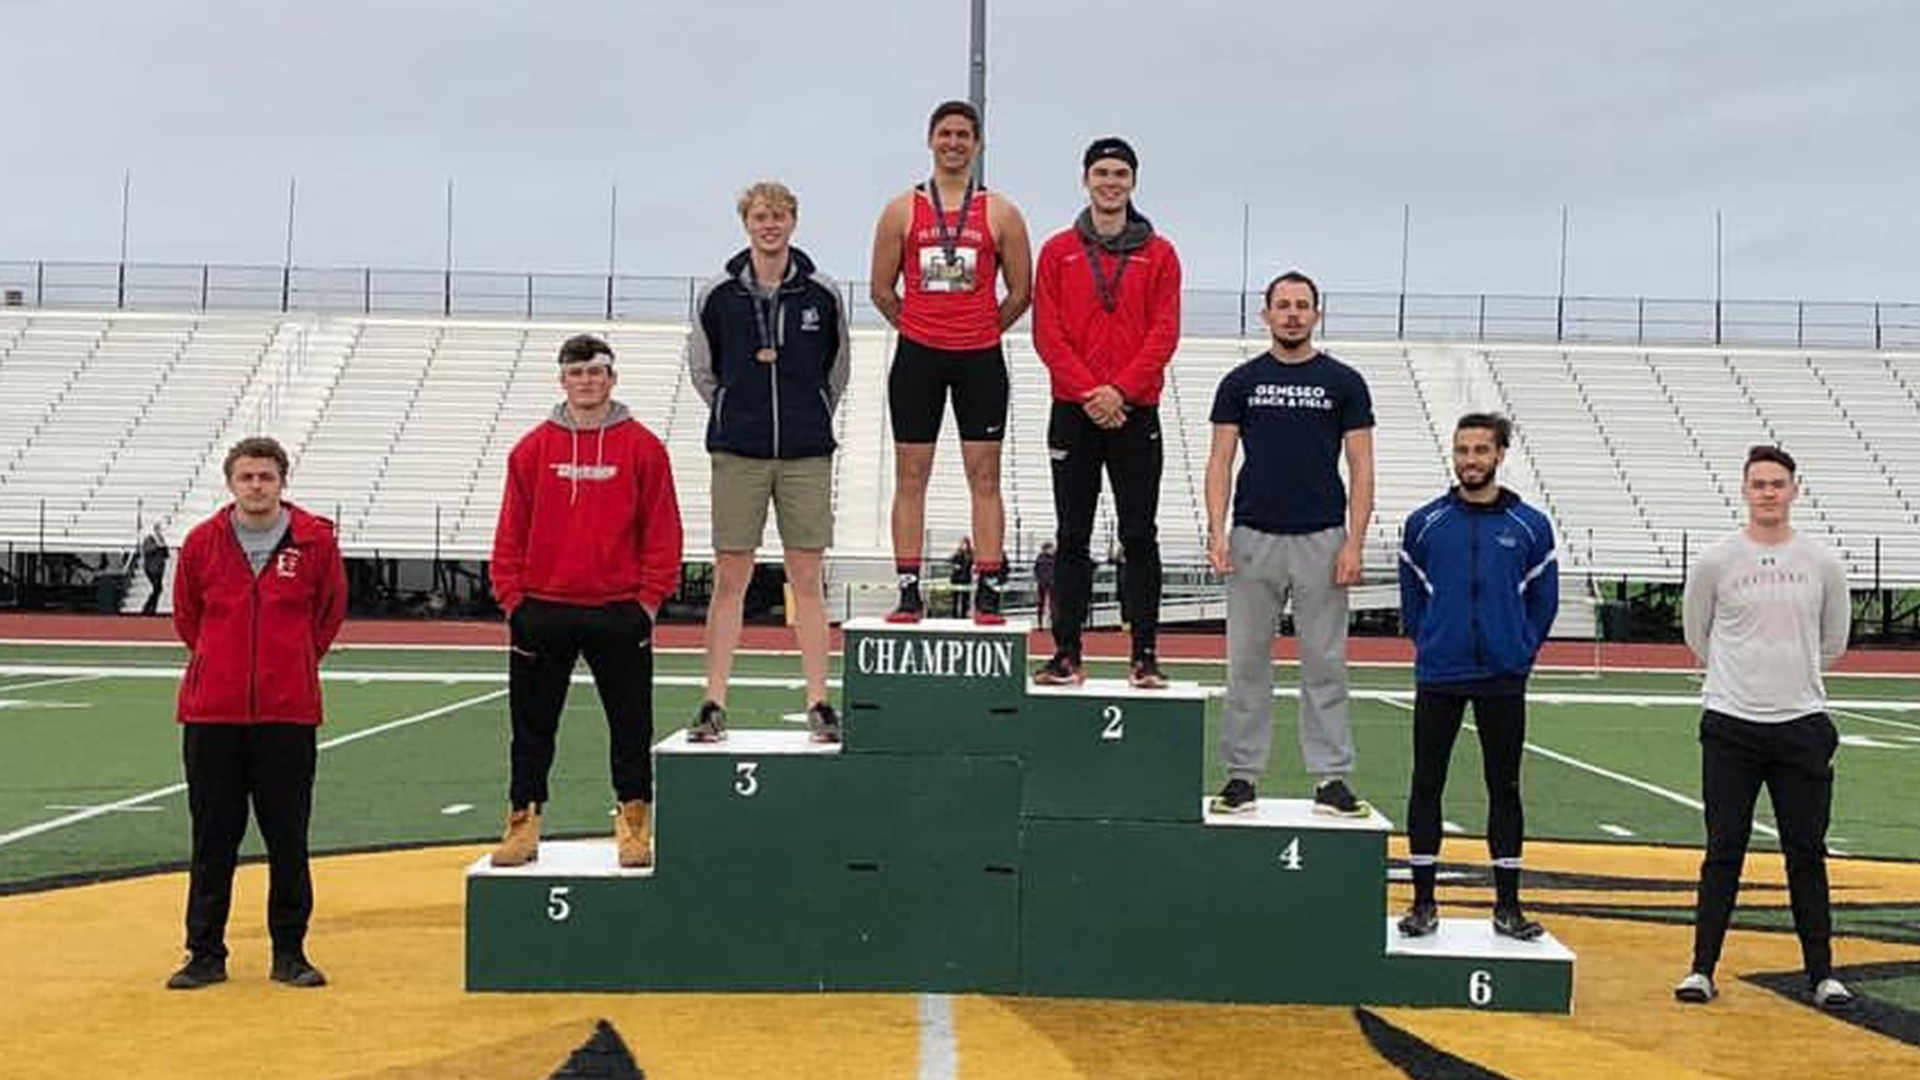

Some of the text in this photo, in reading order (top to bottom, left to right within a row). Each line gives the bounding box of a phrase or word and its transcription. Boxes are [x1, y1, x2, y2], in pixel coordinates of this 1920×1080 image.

[1255, 384, 1325, 398] GENESEO
[857, 636, 1014, 677] CHAMPION
[1102, 705, 1123, 739] 2
[735, 762, 758, 796] 3
[1280, 837, 1302, 870] 4
[547, 886, 570, 921] 5
[1469, 970, 1492, 1005] 6
